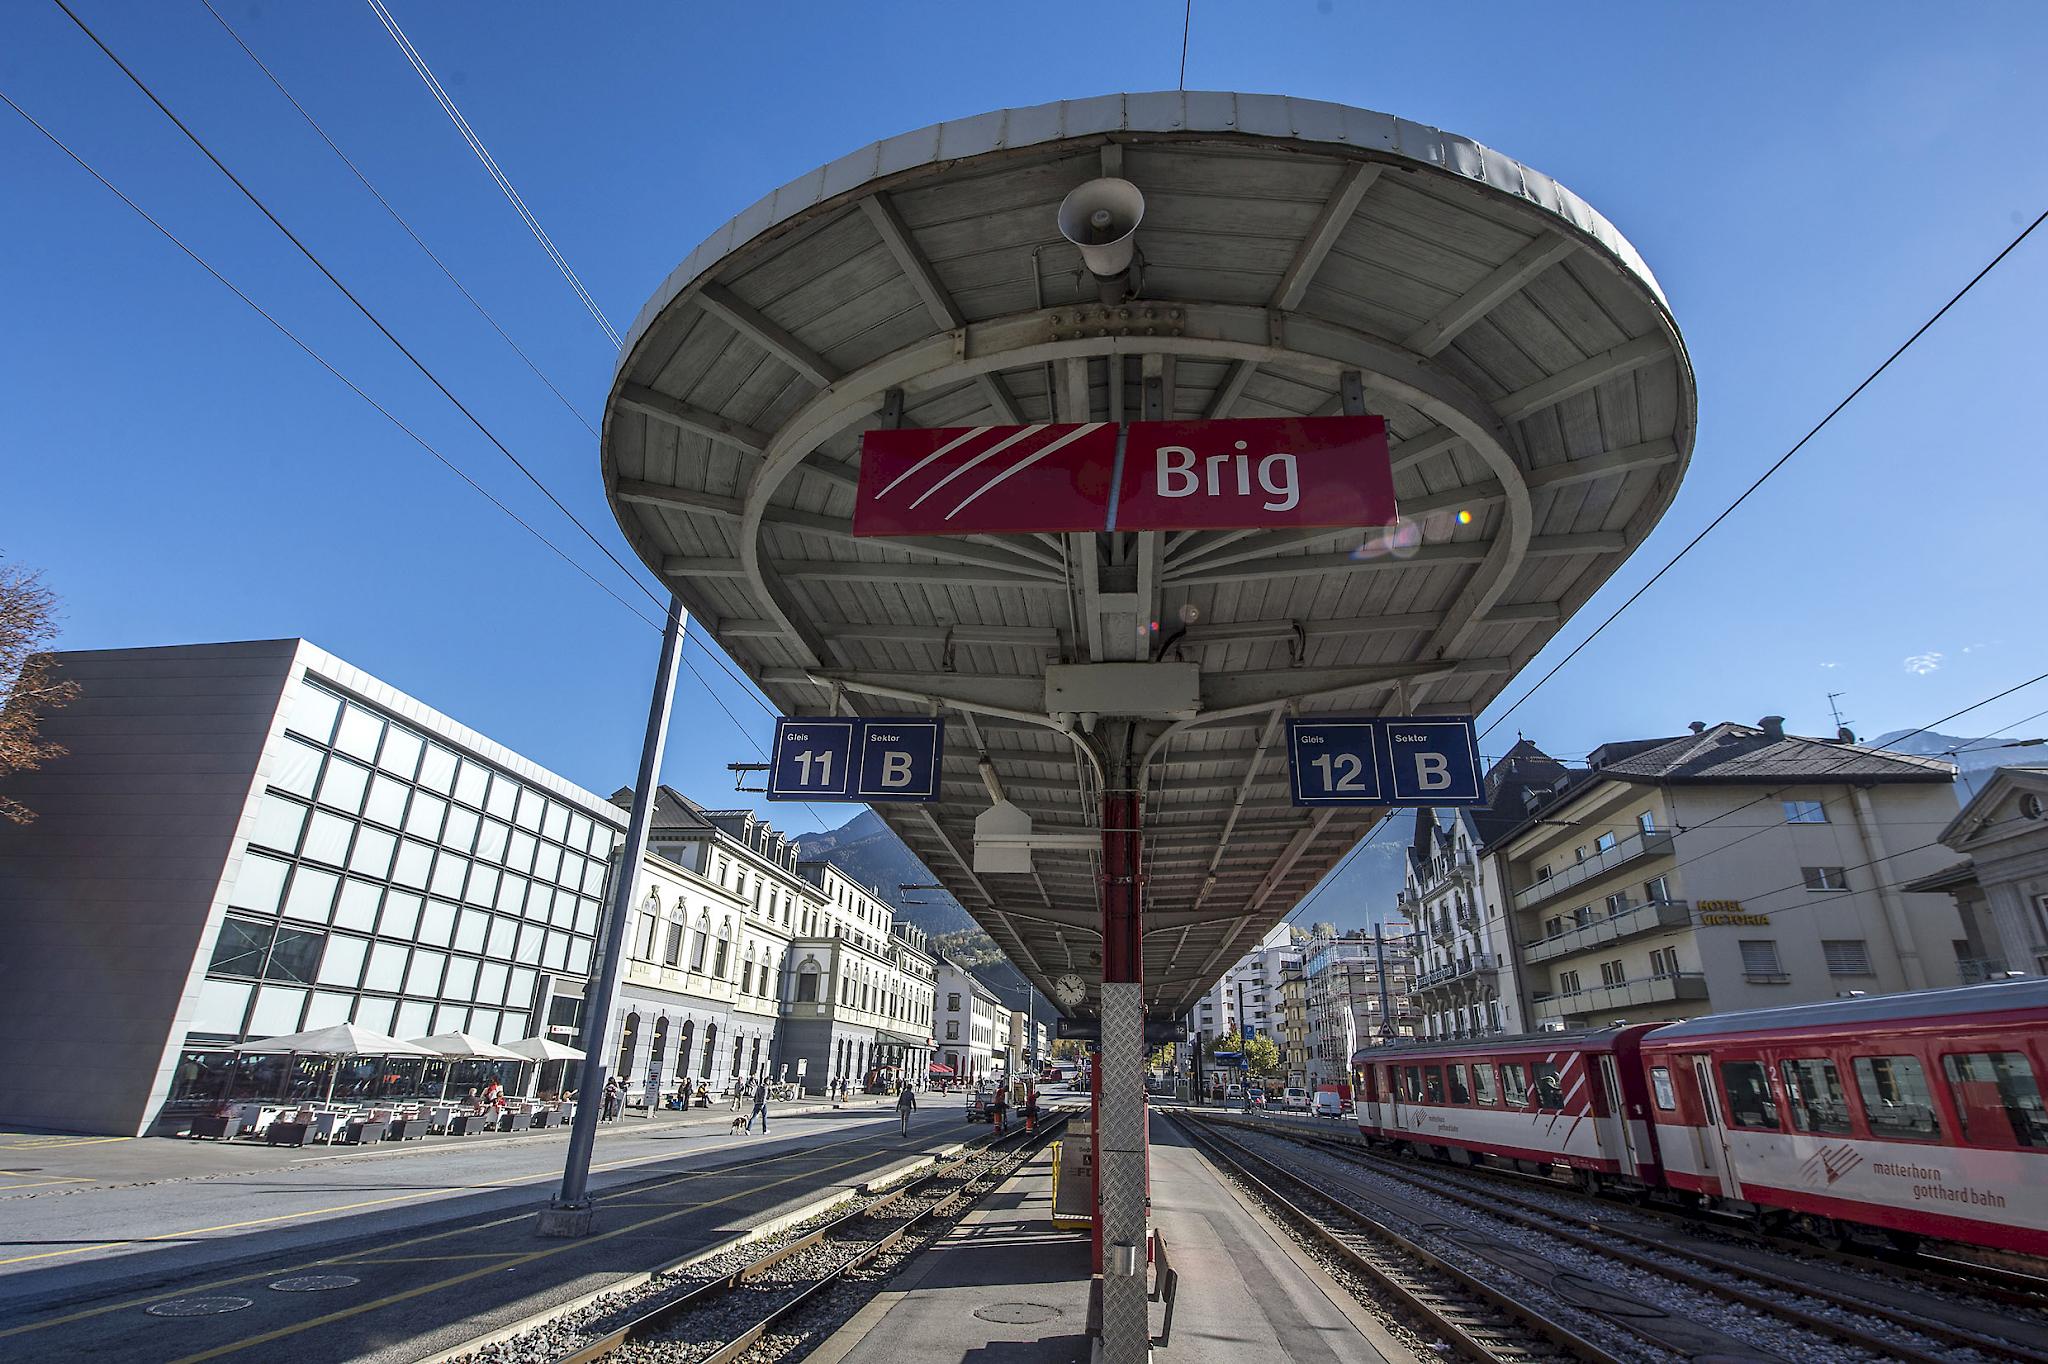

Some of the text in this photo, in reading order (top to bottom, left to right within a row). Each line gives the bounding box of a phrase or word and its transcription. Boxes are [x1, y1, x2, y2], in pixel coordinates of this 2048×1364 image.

[1156, 440, 1300, 512] Brig
[787, 733, 809, 742] Gleis
[871, 734, 900, 742] Sektor
[1301, 735, 1325, 744] Gleis
[1395, 734, 1428, 743] Sektor
[794, 750, 833, 786] 11
[881, 751, 913, 787] B
[1311, 753, 1366, 792] 12
[1414, 752, 1452, 791] B
[1697, 900, 1745, 912] HOTEL
[1702, 914, 1771, 926] VICTORIA
[1769, 1066, 1779, 1081] 2
[1873, 1161, 1941, 1181] matterhorn
[1913, 1183, 1969, 1203] gotthard
